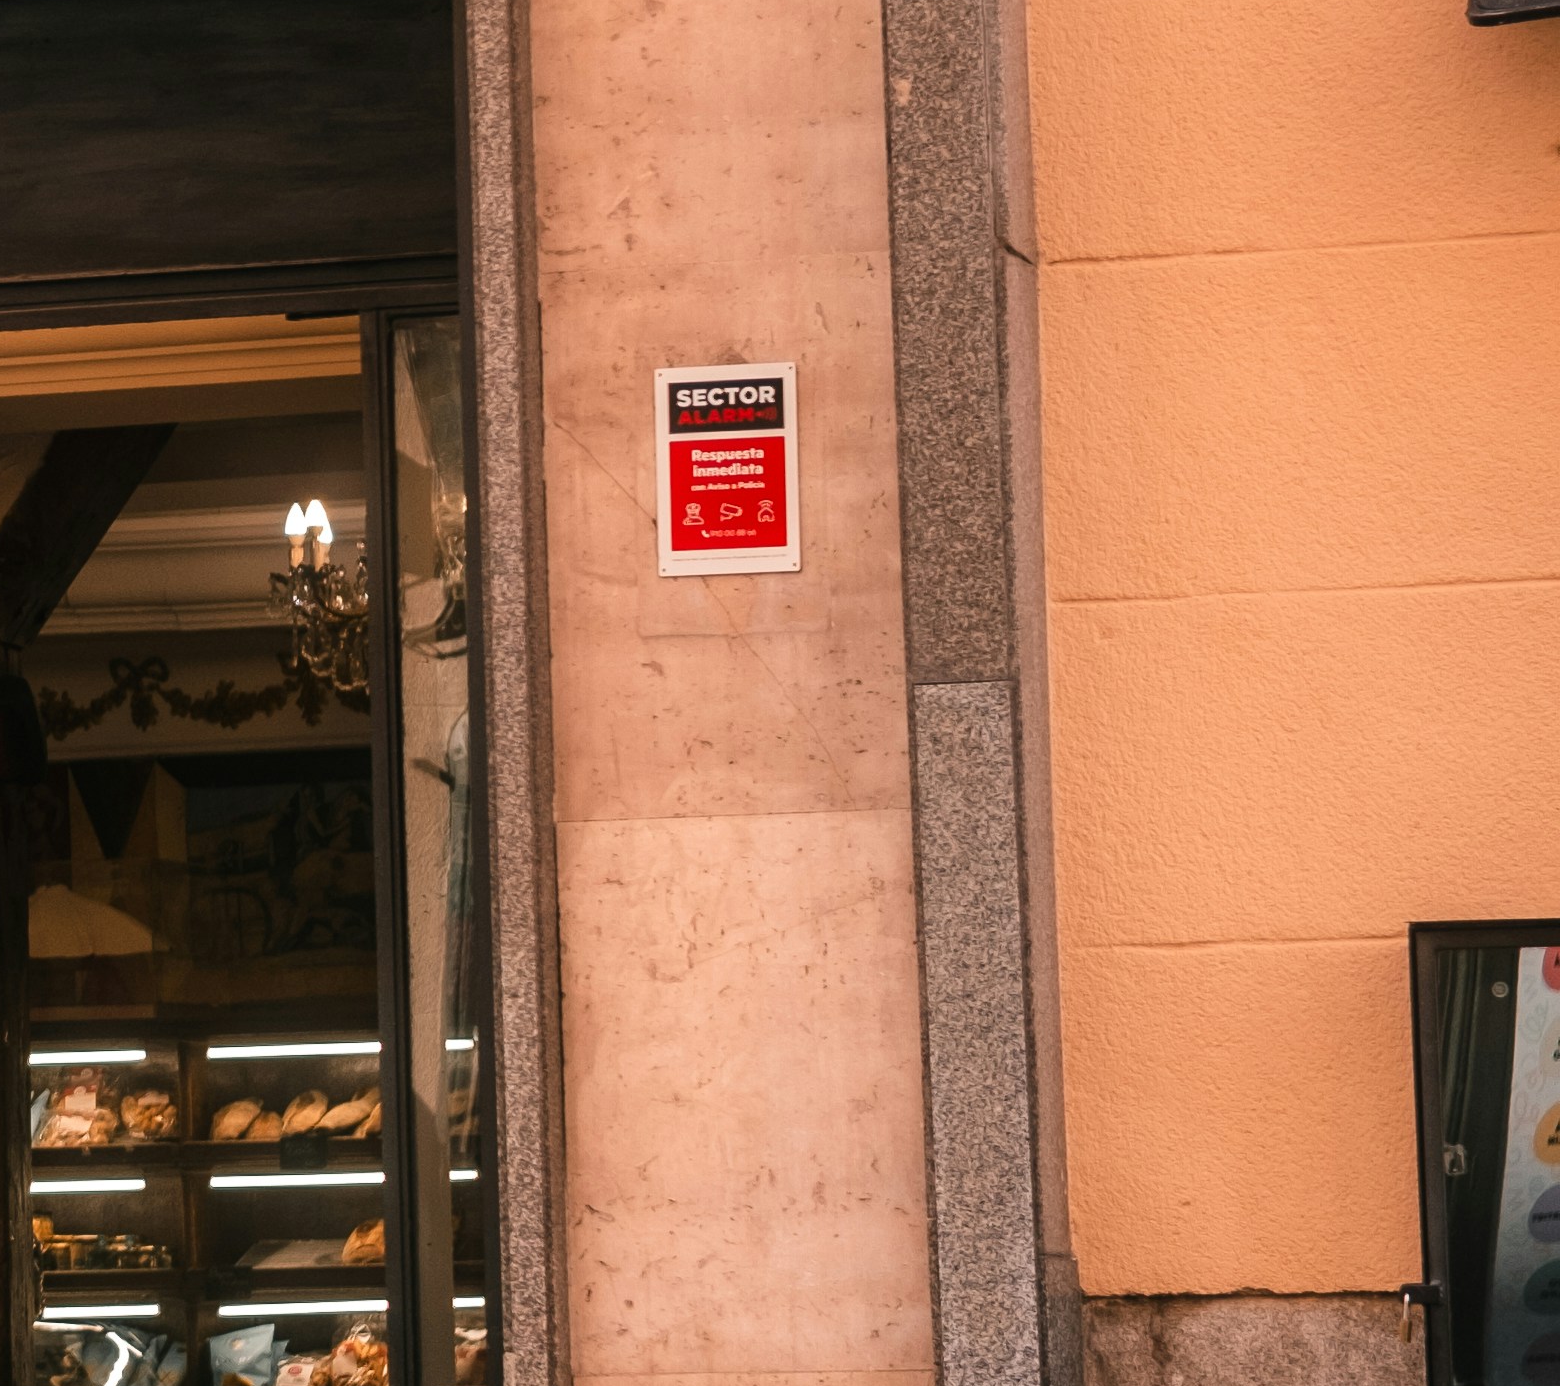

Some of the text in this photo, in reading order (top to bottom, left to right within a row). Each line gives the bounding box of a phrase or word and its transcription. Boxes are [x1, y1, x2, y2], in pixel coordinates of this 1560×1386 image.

[676, 386, 776, 408] SECTOR
[677, 407, 756, 426] ALARM
[691, 448, 765, 463] Respuesta
